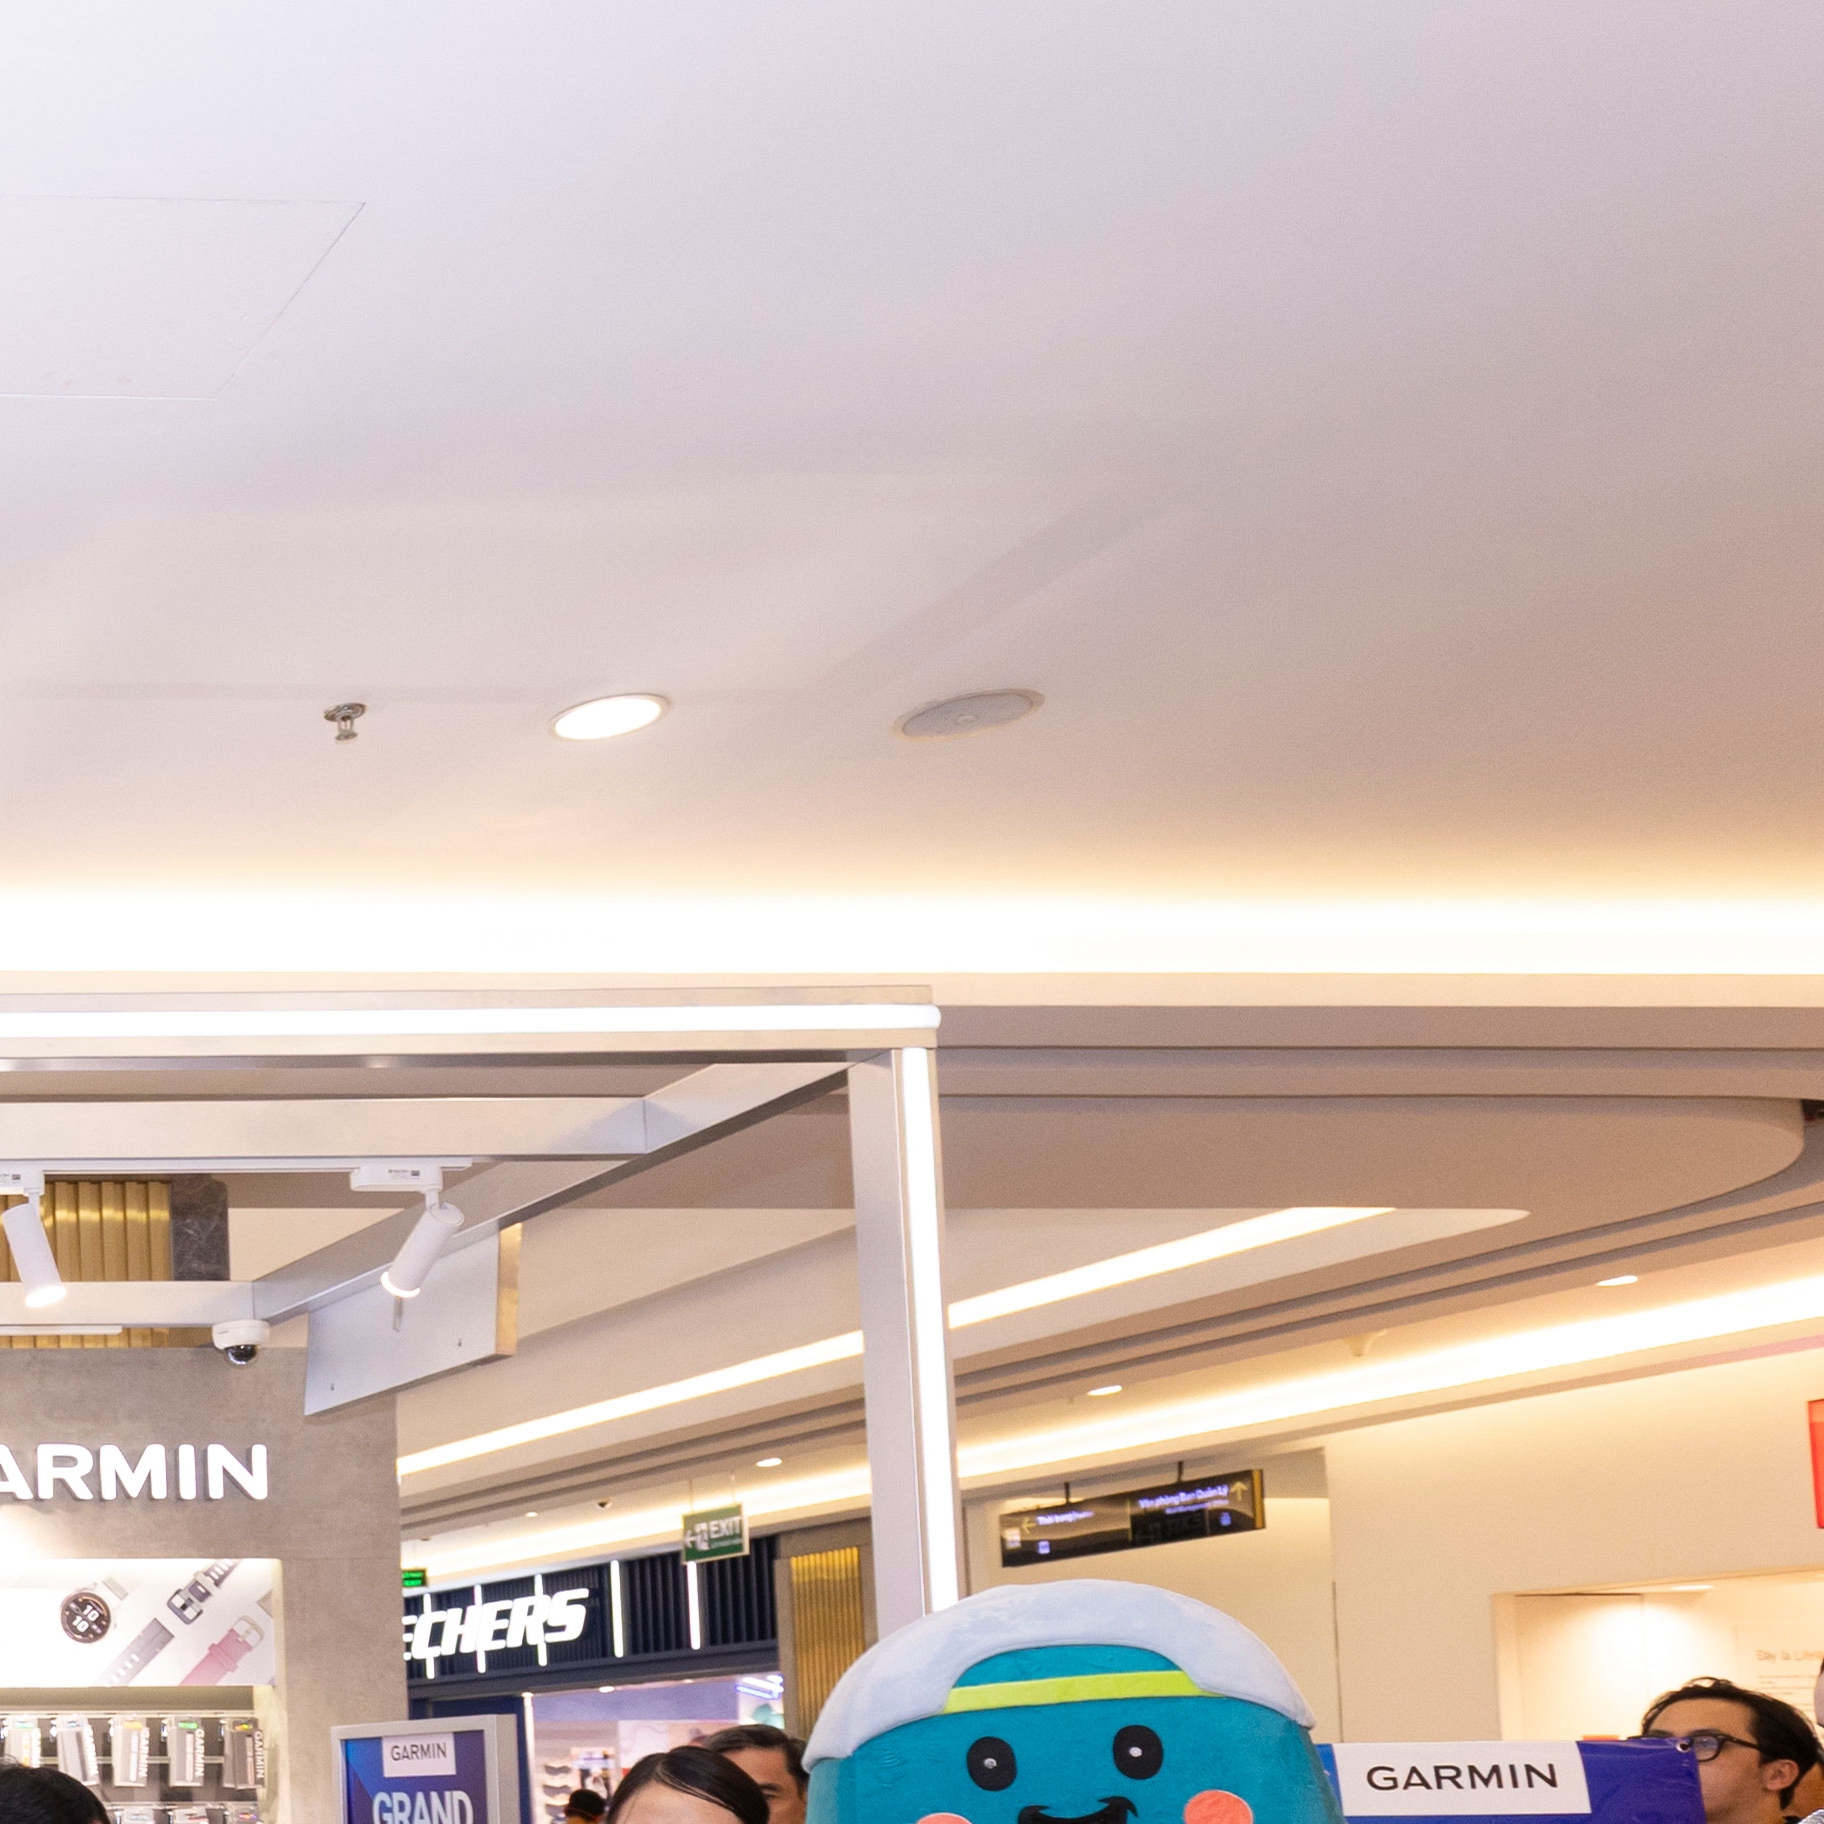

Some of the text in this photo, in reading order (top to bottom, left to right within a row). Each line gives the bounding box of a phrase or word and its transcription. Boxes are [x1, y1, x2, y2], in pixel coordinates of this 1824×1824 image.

[708, 1515, 741, 1539] EXIT
[195, 1729, 205, 1778] GARMIN
[254, 1730, 265, 1780] GARMIN
[390, 1741, 447, 1762] GARMIN
[1366, 1763, 1559, 1791] GARMIN
